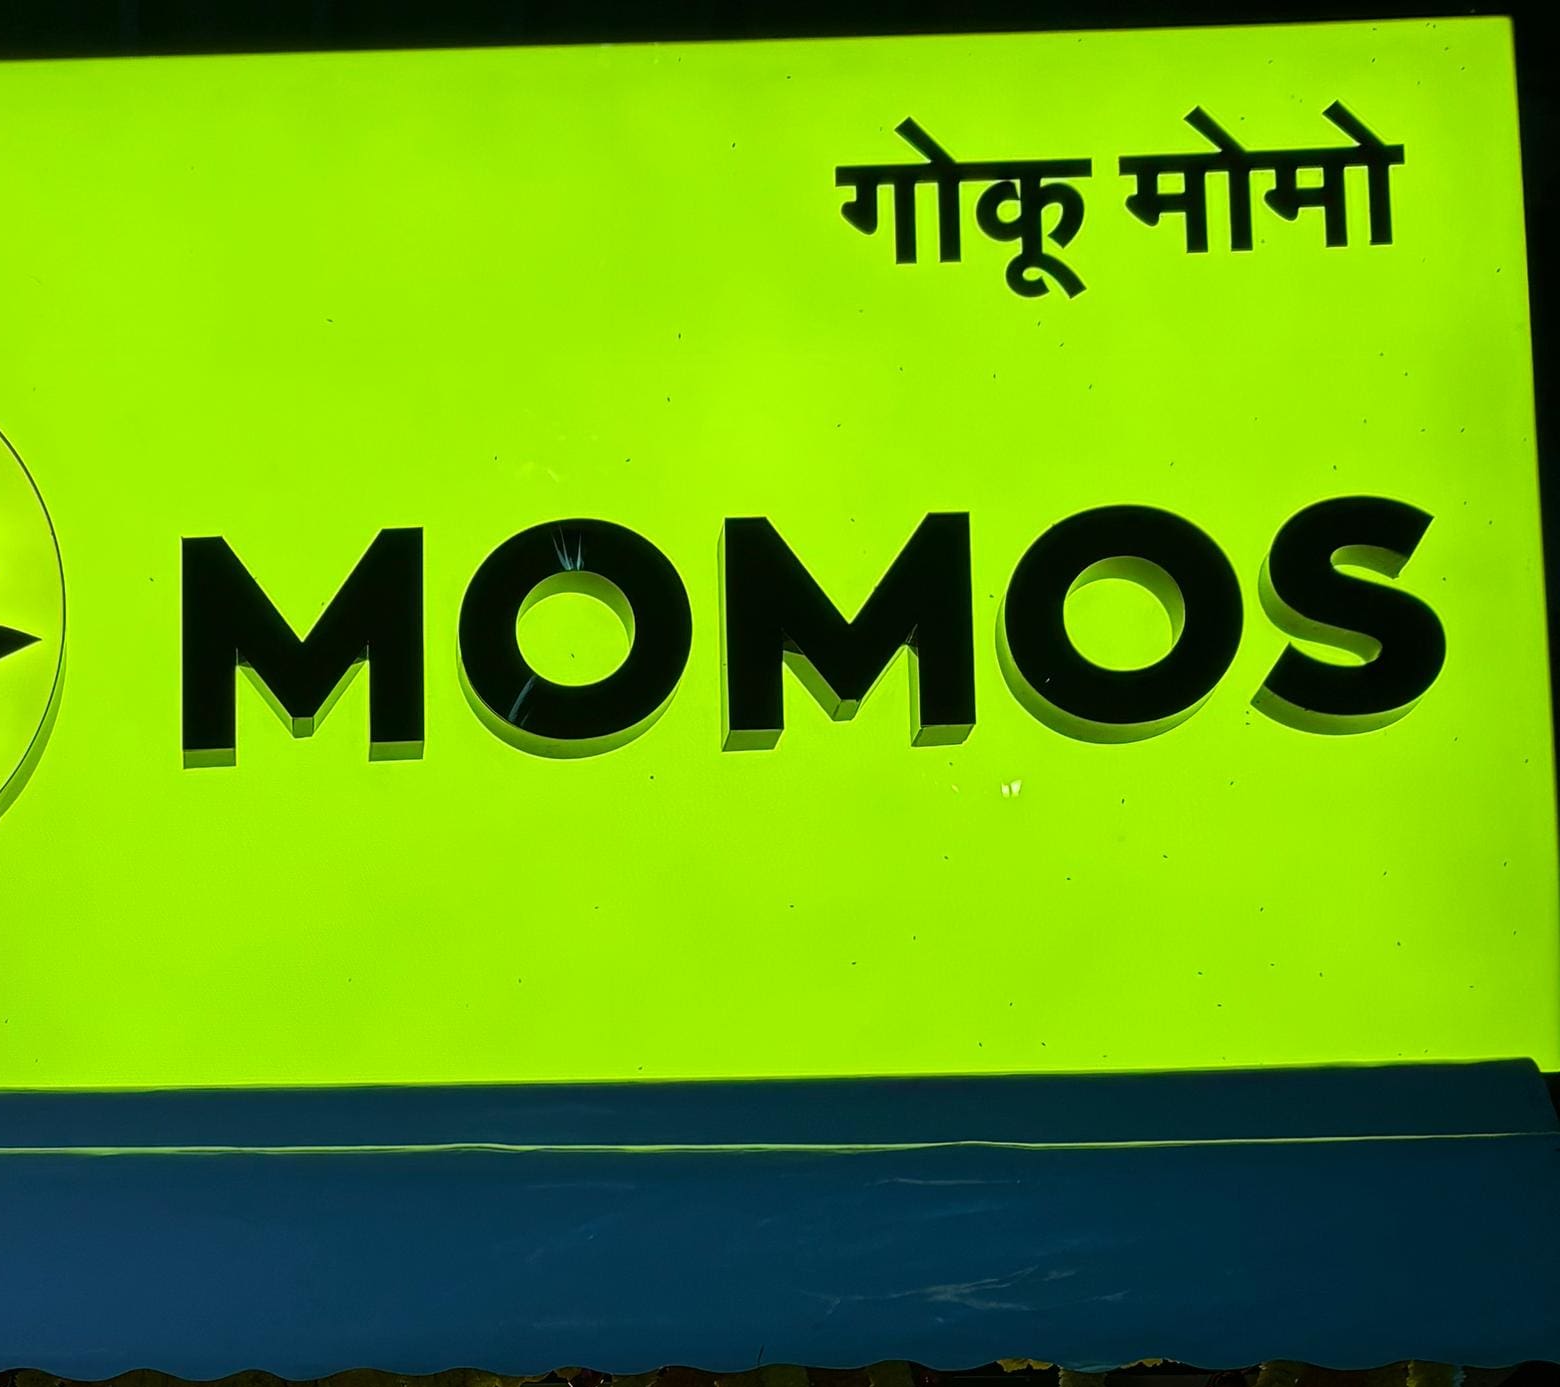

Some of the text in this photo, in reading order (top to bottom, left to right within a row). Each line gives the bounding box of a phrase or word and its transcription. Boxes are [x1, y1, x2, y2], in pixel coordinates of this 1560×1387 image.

[835, 100, 1406, 298] गोकू मोमो
[181, 496, 1446, 762] MOMOS
